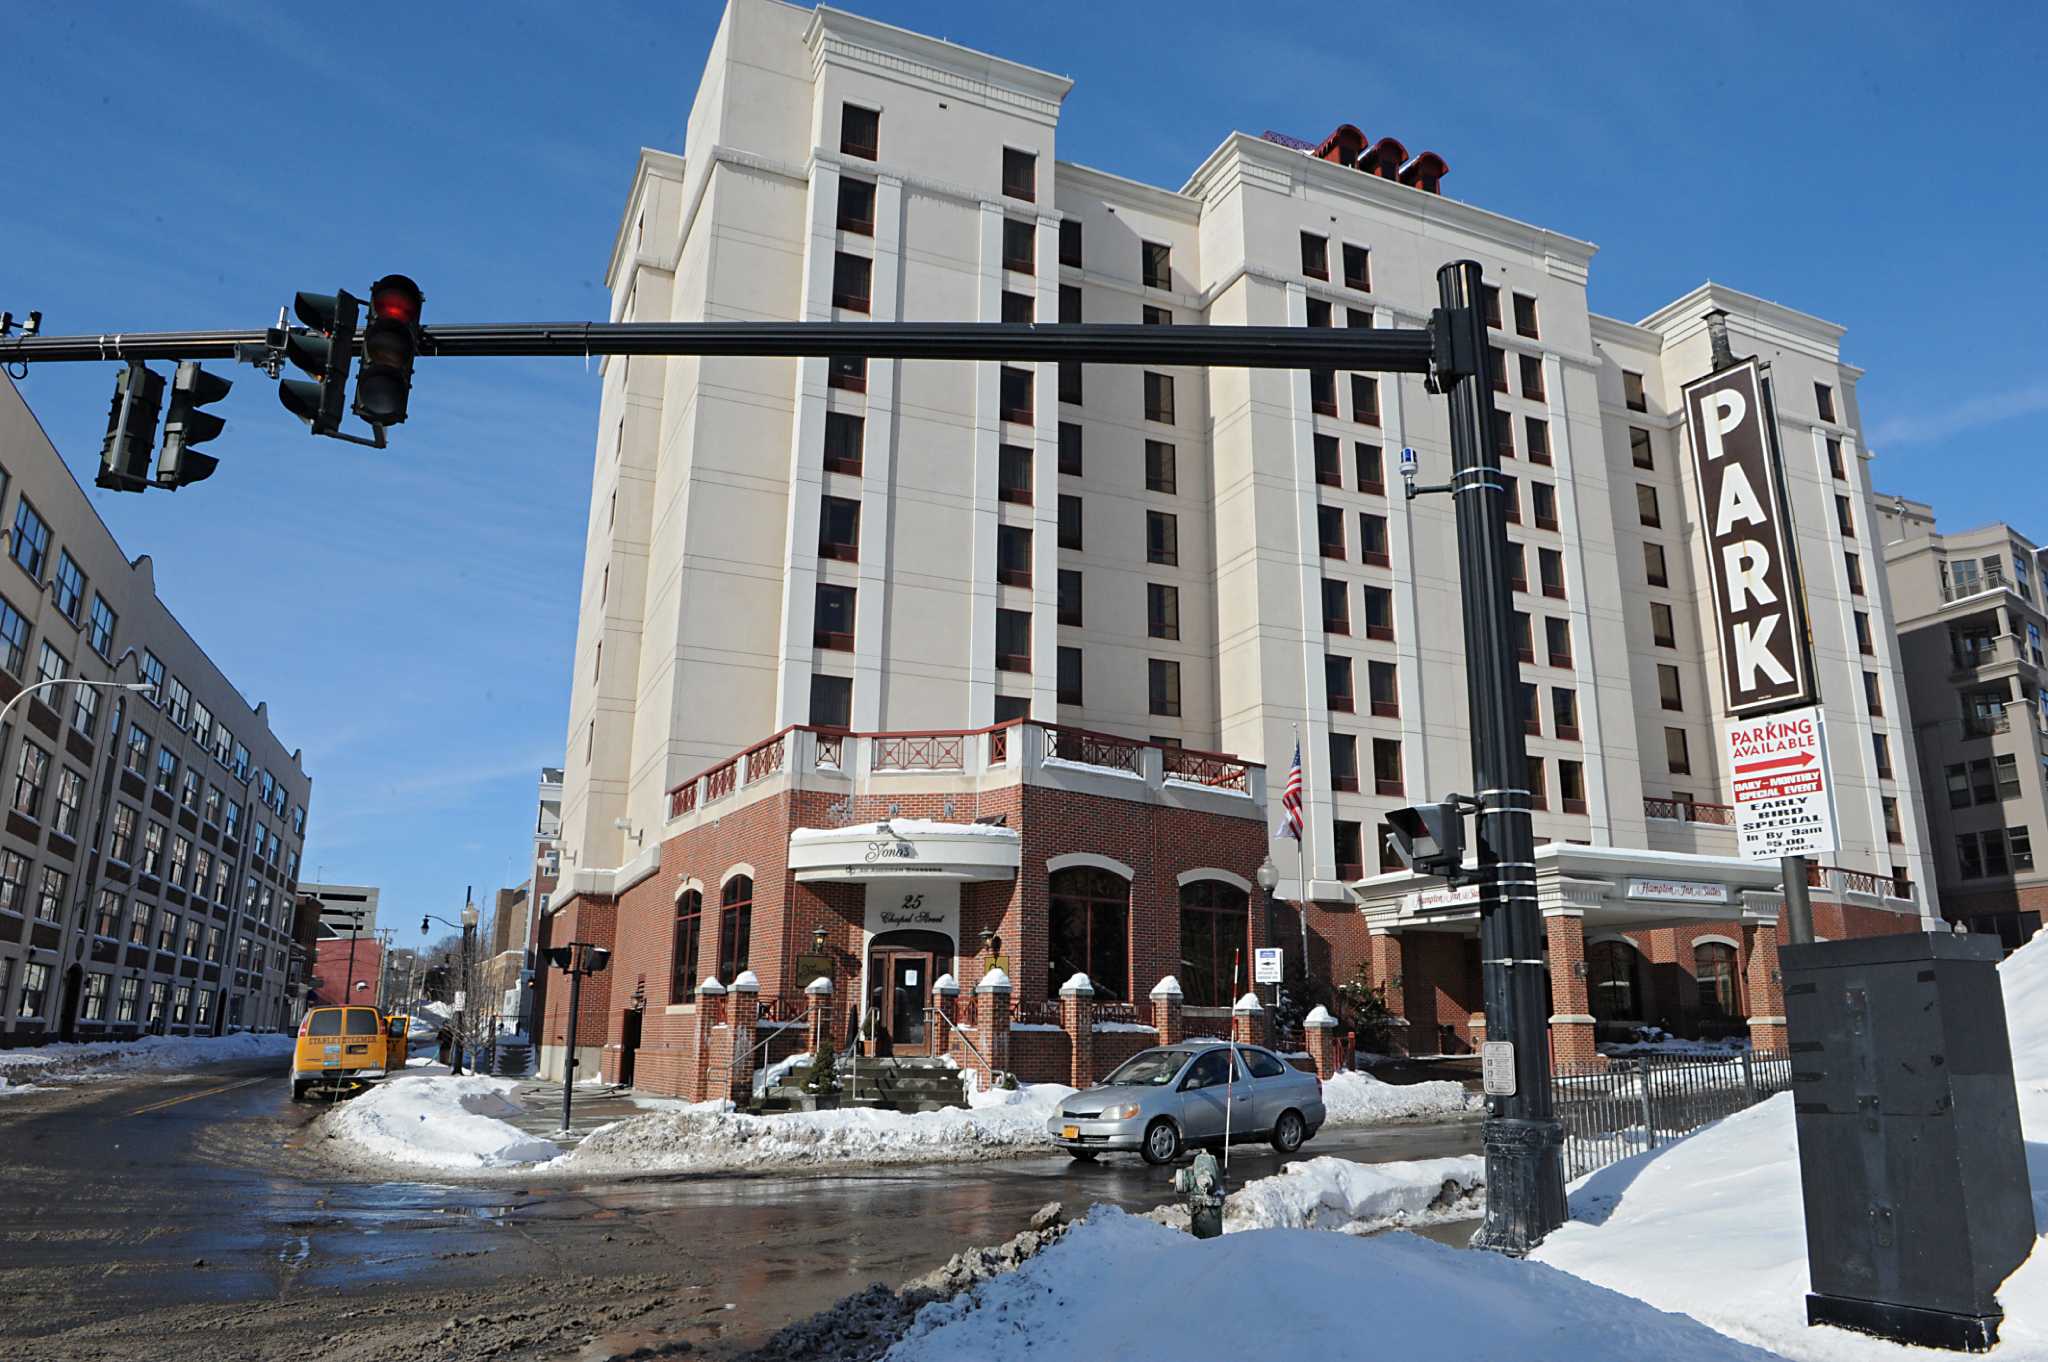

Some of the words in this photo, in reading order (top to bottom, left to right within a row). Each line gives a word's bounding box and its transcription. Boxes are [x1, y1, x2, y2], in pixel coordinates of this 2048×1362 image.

[1700, 388, 1795, 693] PARK
[1731, 719, 1812, 746] PARKING
[1733, 735, 1815, 758] AVAILABLE
[1734, 780, 1761, 792] DAILY
[1769, 772, 1819, 786] MONTHLY
[1739, 788, 1779, 801] SPECIAL
[1783, 782, 1817, 794] EVENT
[1750, 797, 1808, 811] EARLY
[1758, 807, 1804, 819] BIRD
[1743, 814, 1823, 831] SPECIAL
[1791, 827, 1822, 836] 9am
[1640, 881, 1674, 895] Hampton
[1679, 884, 1694, 896] Inn
[901, 894, 924, 909] 25
[880, 911, 914, 927] Chapel
[914, 911, 945, 924] Street
